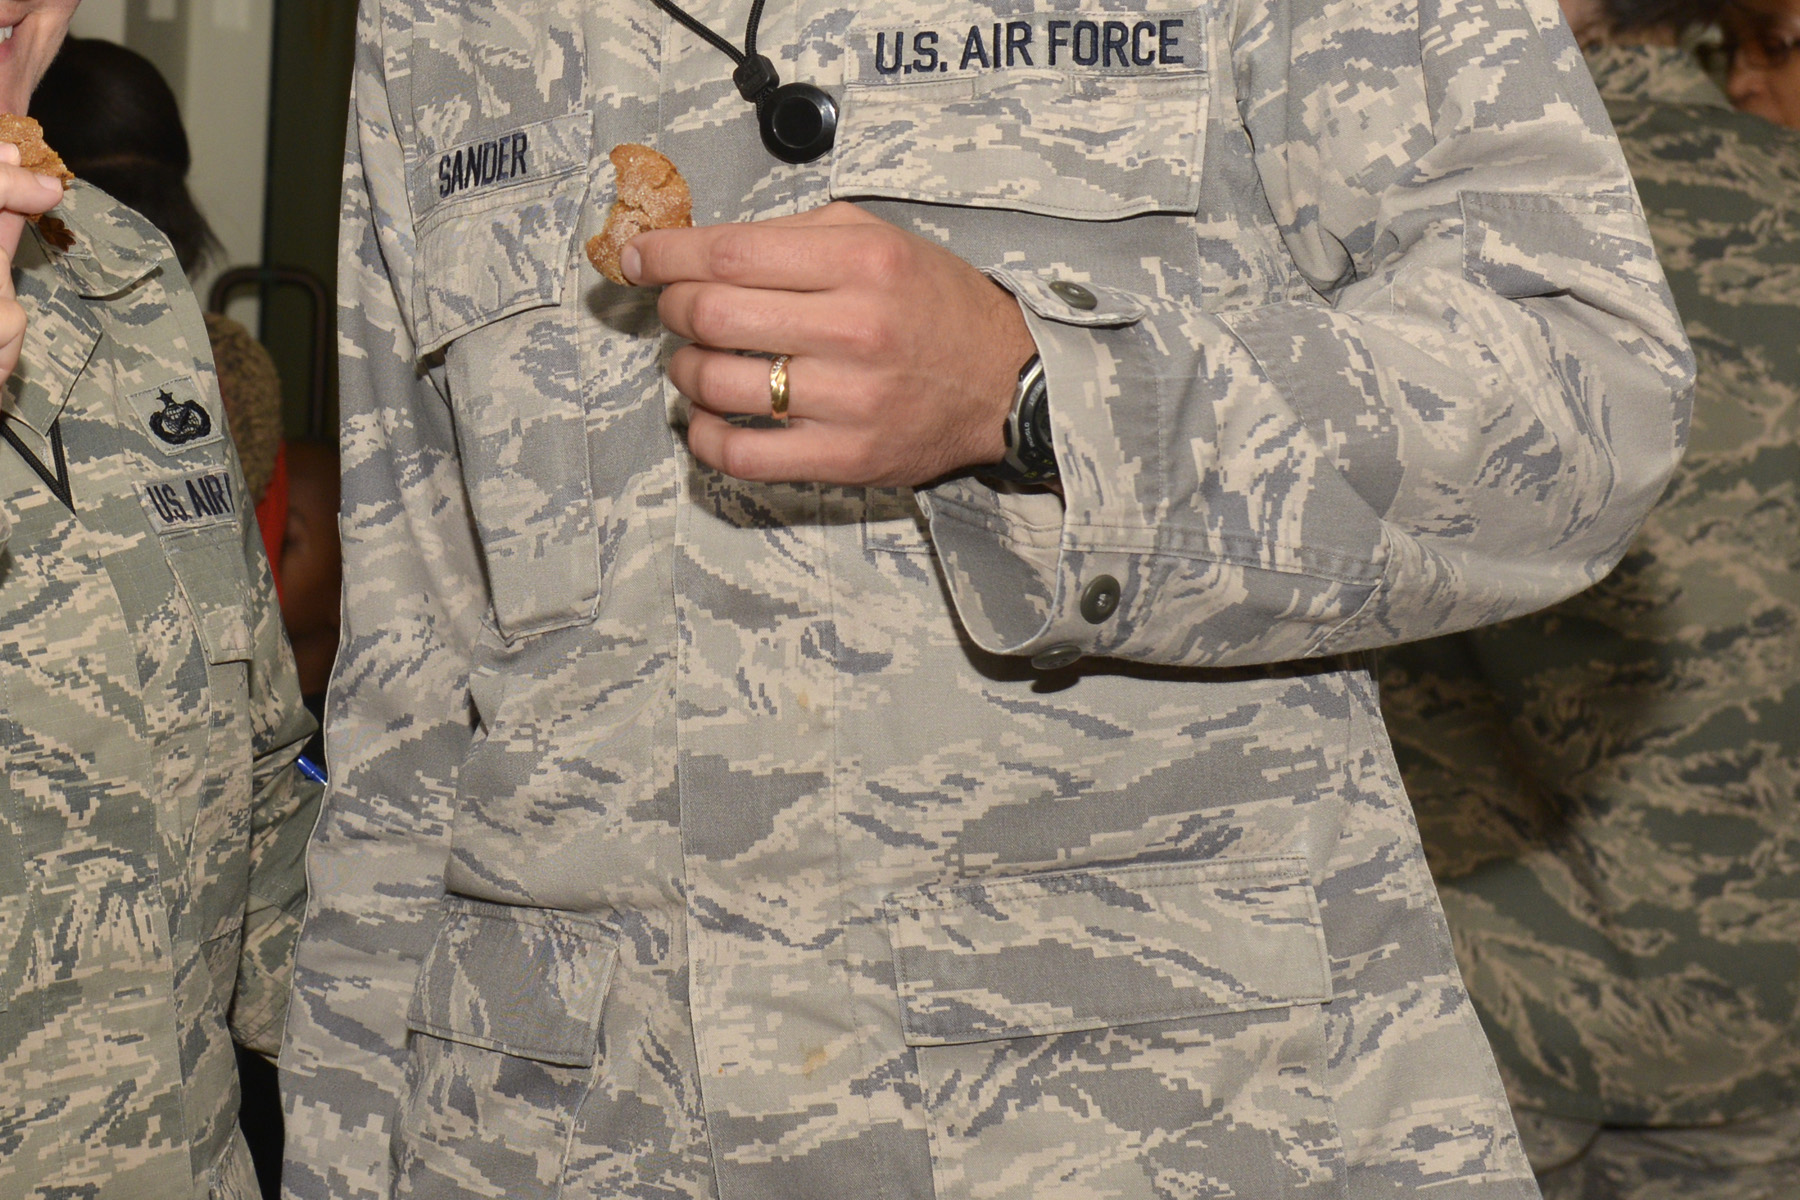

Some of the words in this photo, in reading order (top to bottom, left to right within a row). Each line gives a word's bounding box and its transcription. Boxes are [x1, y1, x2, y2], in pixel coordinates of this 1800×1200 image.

[875, 31, 947, 75] U.S.
[959, 21, 1034, 70] AIR
[1048, 19, 1184, 67] FORCE
[439, 132, 528, 199] SANDER
[185, 474, 231, 519] AIR
